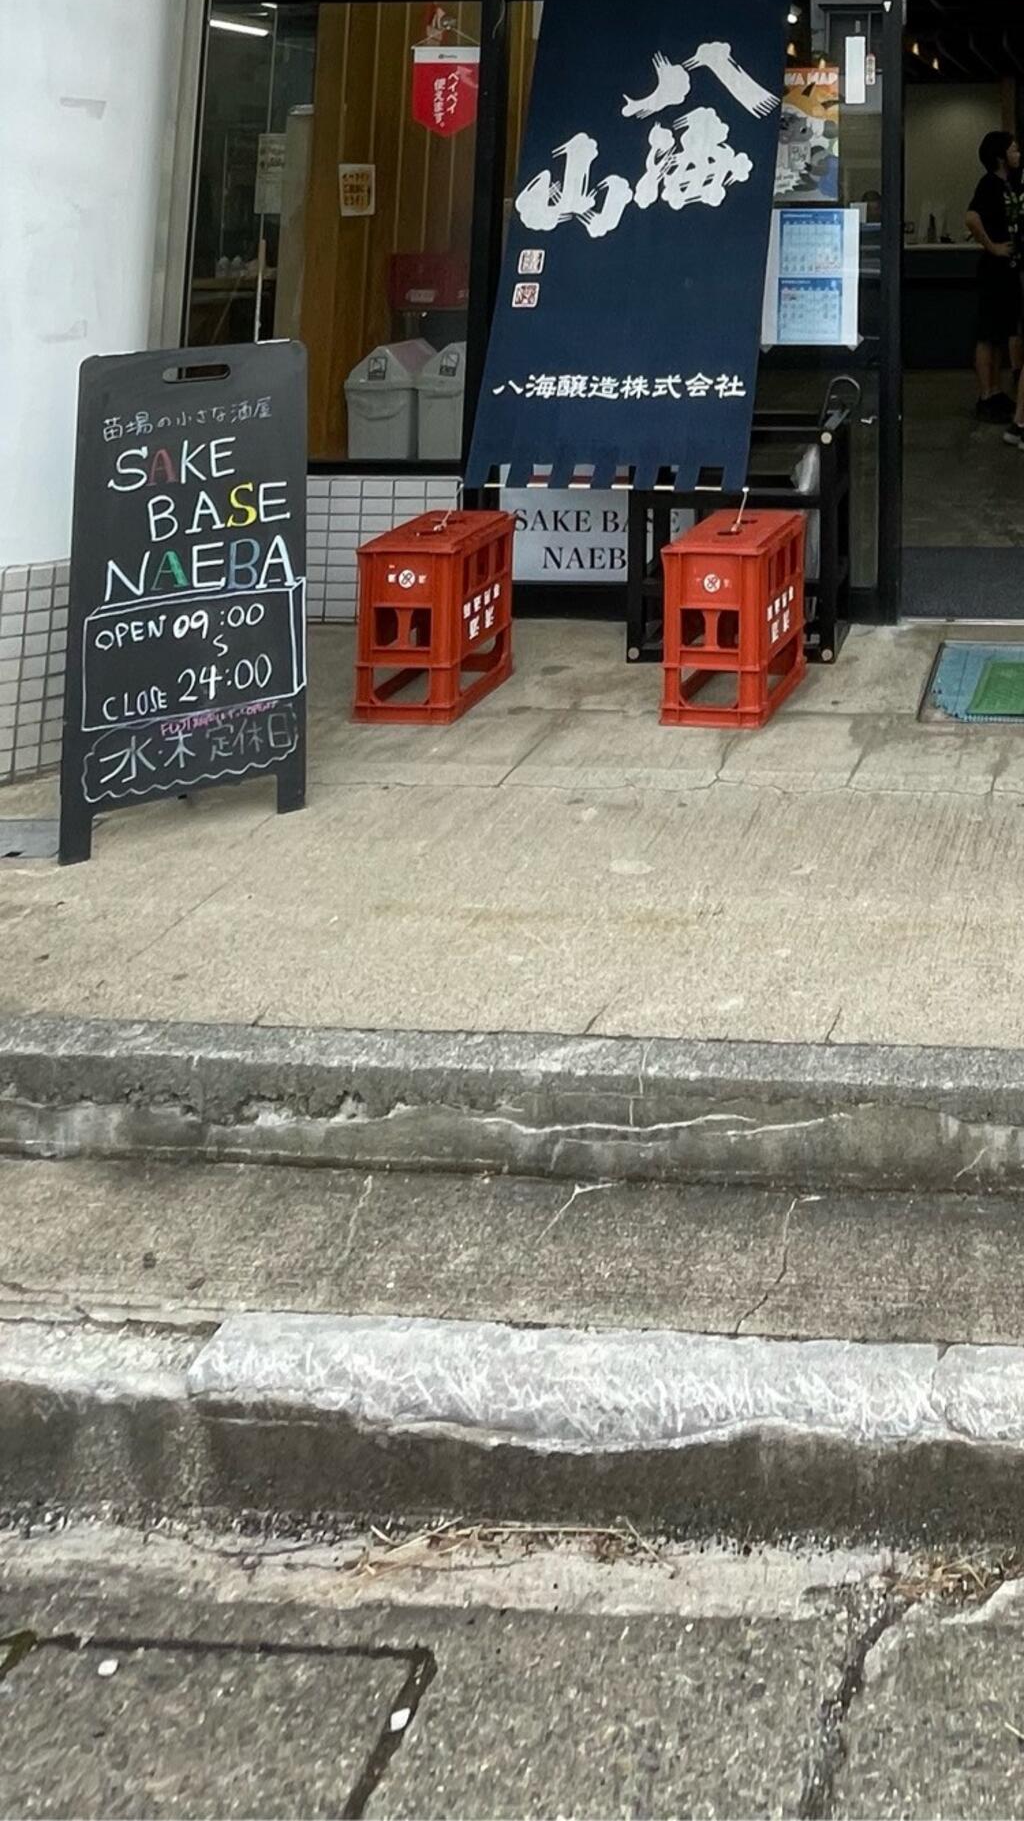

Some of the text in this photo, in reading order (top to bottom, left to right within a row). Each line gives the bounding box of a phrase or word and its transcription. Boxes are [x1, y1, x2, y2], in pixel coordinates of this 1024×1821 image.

[492, 372, 747, 400] 八海醸造株式会社
[102, 396, 273, 442] 苗場の小さな酒屋
[107, 436, 236, 492] SAKE
[147, 481, 291, 542] BASE
[514, 508, 592, 533] SAKE
[104, 534, 299, 602] NAEBA
[542, 546, 628, 570] NAEB
[95, 602, 265, 650] OPEN 09:00
[102, 685, 168, 721] CLOSE
[177, 653, 272, 702] 24:00
